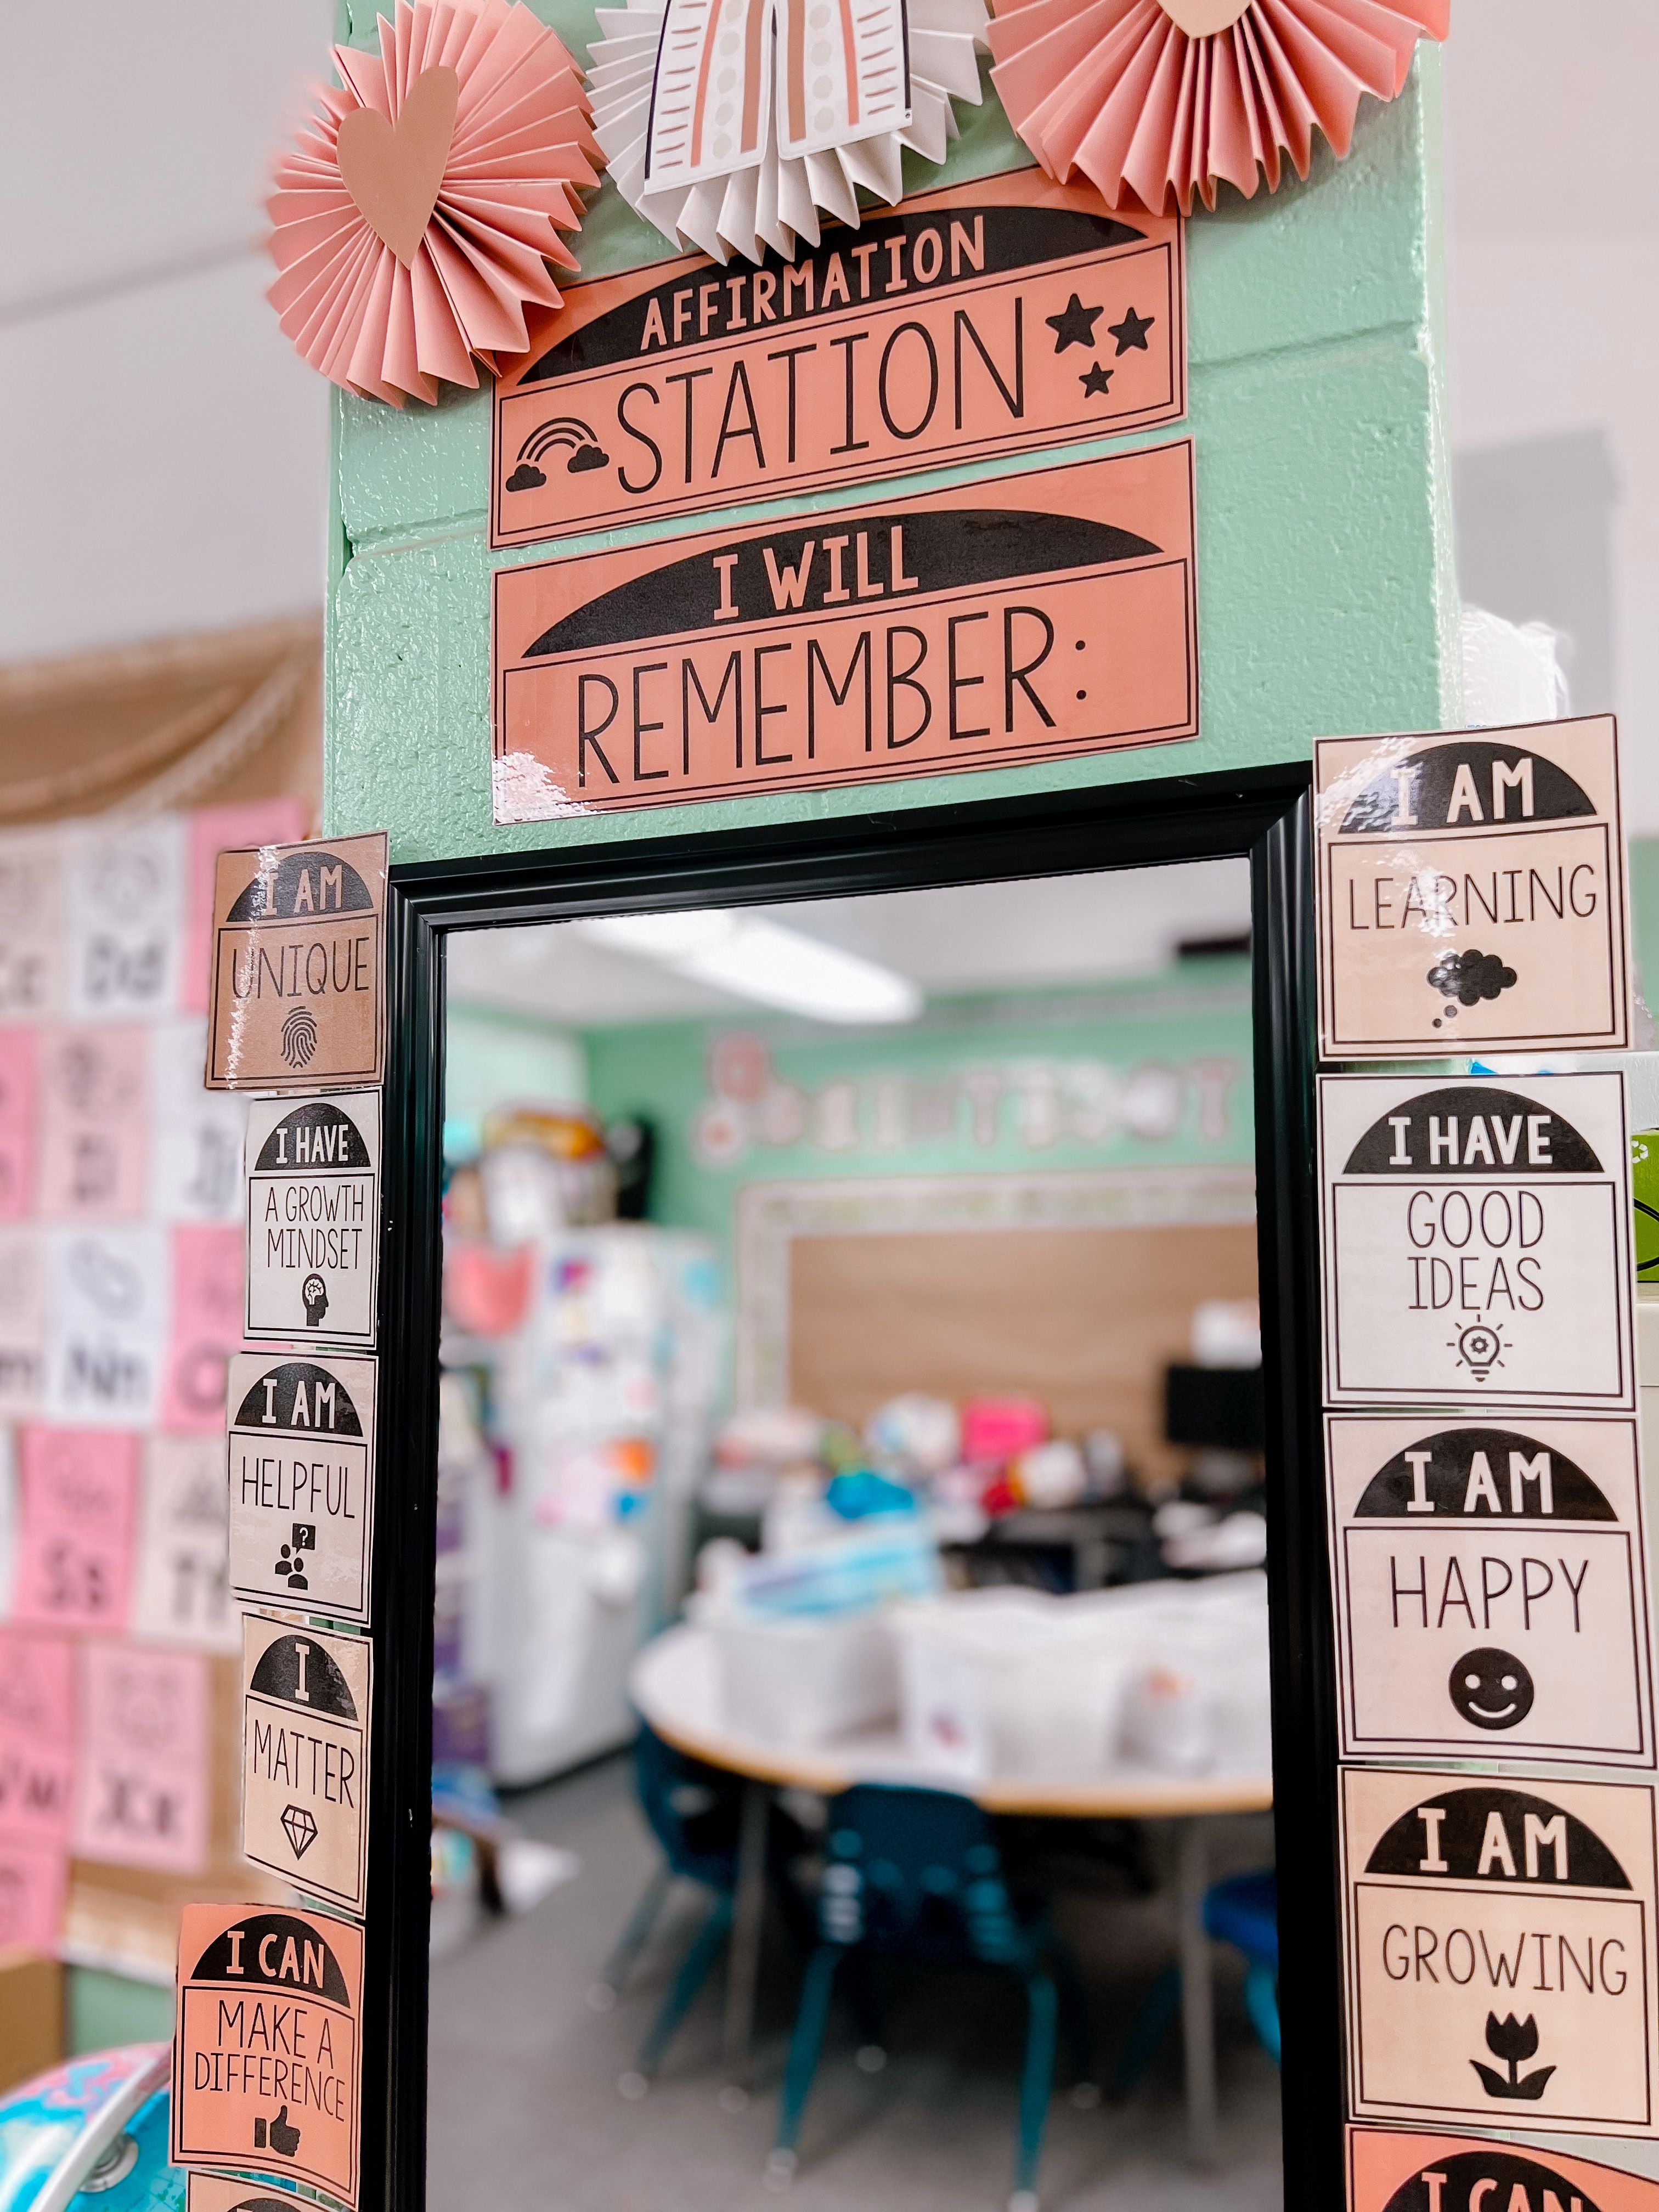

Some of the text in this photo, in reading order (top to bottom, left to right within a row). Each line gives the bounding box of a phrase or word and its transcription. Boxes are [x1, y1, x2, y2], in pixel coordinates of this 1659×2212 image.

[639, 215, 987, 351] AFFIRMATION
[616, 297, 1024, 494] STATION
[712, 526, 918, 620] I WILL
[578, 606, 1087, 788] REMEMBER:
[1391, 758, 1534, 826] I AM
[266, 865, 343, 917] I AM
[1348, 864, 1597, 930] LEARNING
[232, 936, 370, 1000] UNIQUE
[275, 1124, 348, 1164] I HAVE
[1388, 1114, 1553, 1166] I HAVE
[264, 1184, 364, 1222] A GROWTH
[1407, 1190, 1544, 1249] GOOD
[267, 1228, 363, 1269] MINDSET
[1407, 1256, 1544, 1311] IDEAS
[262, 1379, 336, 1429] I AM
[242, 1456, 356, 1519] HELPFUL
[1404, 1451, 1554, 1514] I AM
[1390, 1555, 1589, 1633] HAPPY
[295, 1643, 310, 1701] I
[253, 1719, 355, 1810] MATTER
[1417, 1807, 1568, 1880] I AM
[227, 1931, 325, 1990] I CAN
[1383, 1924, 1627, 1996] GROWING
[218, 2000, 333, 2069] MAKE A
[194, 2051, 346, 2123] DIFFERENCE
